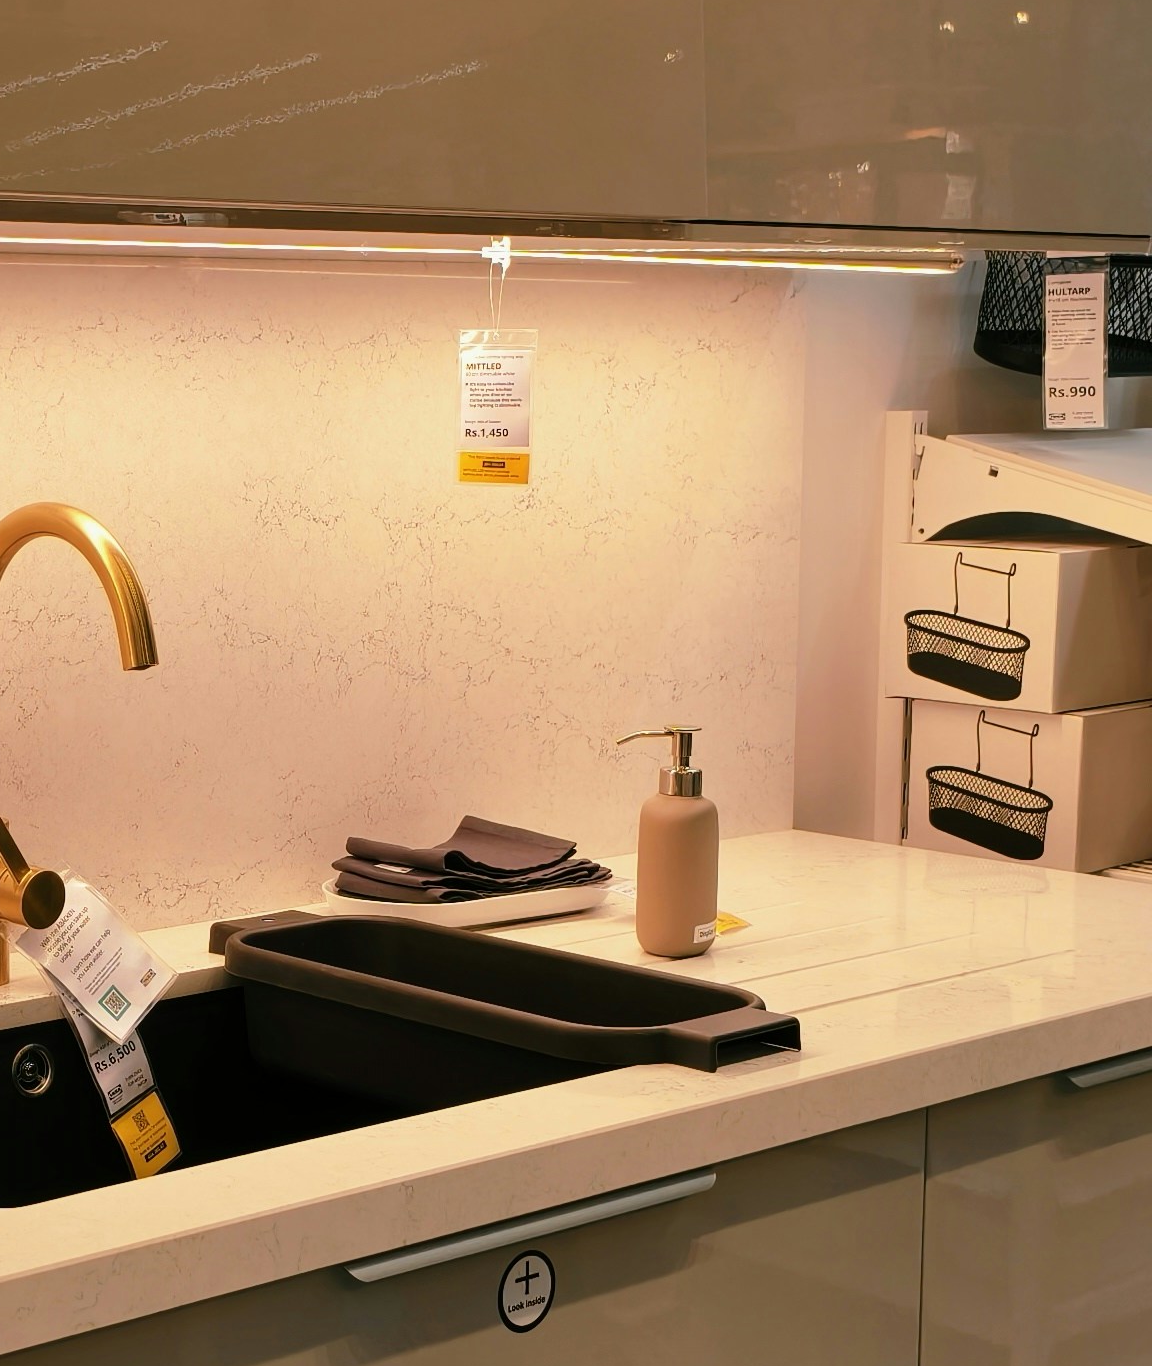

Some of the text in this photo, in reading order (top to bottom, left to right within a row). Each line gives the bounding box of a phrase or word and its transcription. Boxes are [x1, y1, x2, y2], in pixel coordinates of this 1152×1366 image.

[1048, 287, 1090, 295] HULTARP
[1049, 386, 1096, 397] Rs.990
[465, 429, 508, 438] Rs.1,450
[69, 927, 81, 939] your
[70, 960, 83, 975] Learn
[80, 951, 91, 962] how
[94, 937, 103, 947] can
[99, 927, 112, 940] help
[75, 970, 86, 981] you
[82, 961, 93, 972] save
[95, 1041, 135, 1073] Rs.6,500
[508, 1302, 524, 1313] Look
